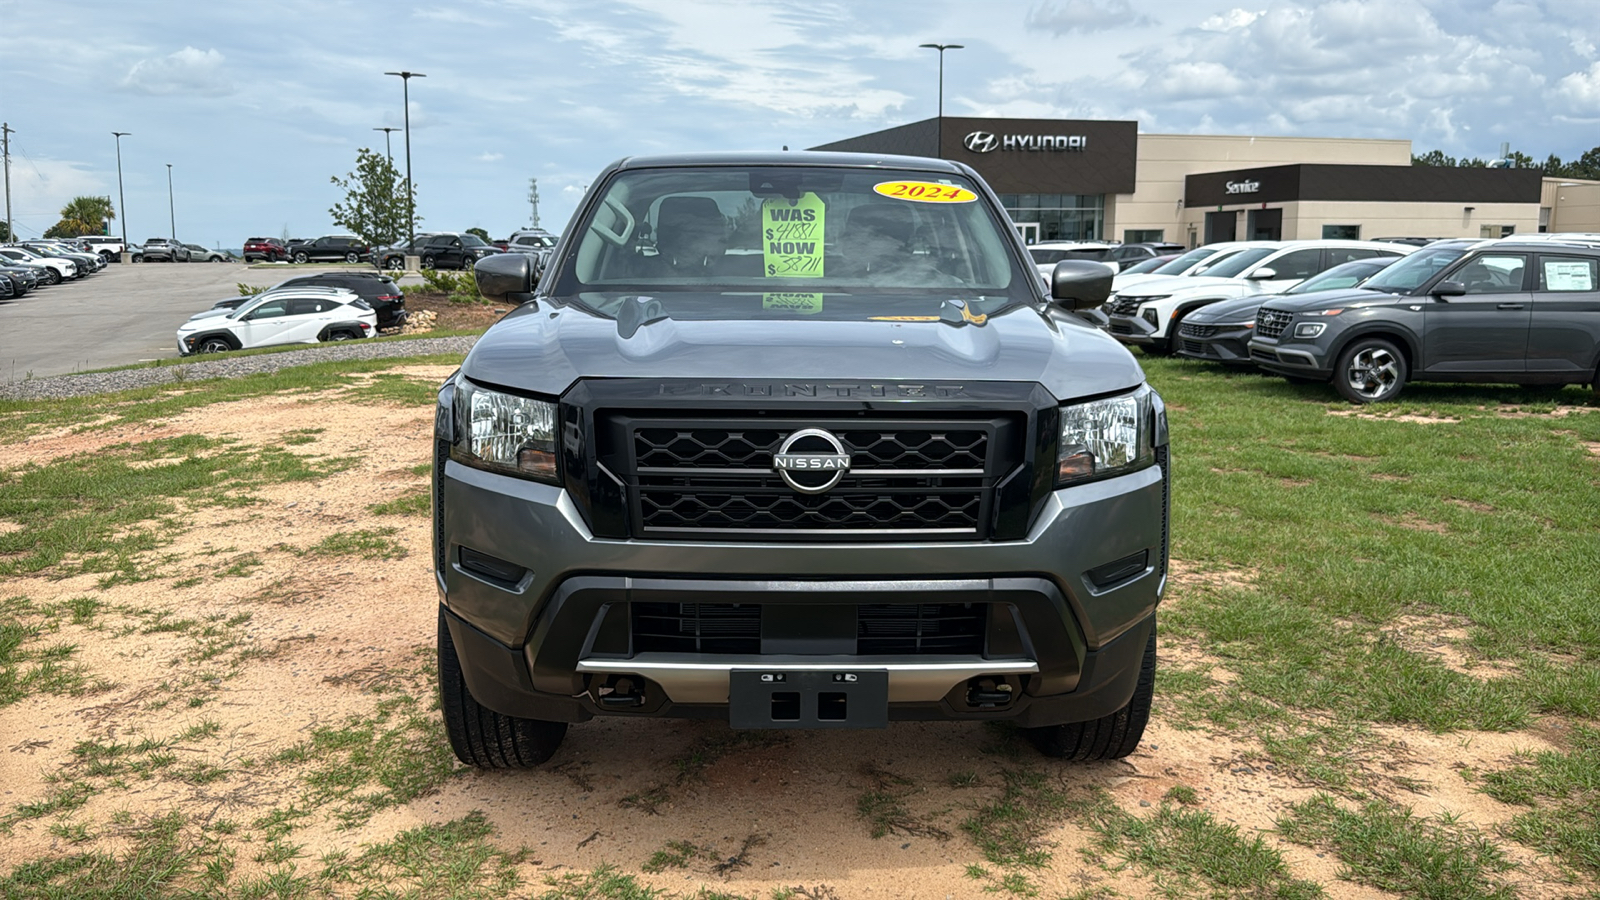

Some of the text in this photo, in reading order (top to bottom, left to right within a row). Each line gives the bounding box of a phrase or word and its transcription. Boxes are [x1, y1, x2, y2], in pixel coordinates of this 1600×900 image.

[1003, 134, 1087, 150] HYUNDAI
[890, 184, 962, 199] 2024
[1225, 179, 1259, 194] Service
[770, 208, 816, 222] WAS
[770, 242, 816, 255] NOW
[659, 383, 969, 398] FRONTIER
[775, 457, 849, 469] NISSAN
